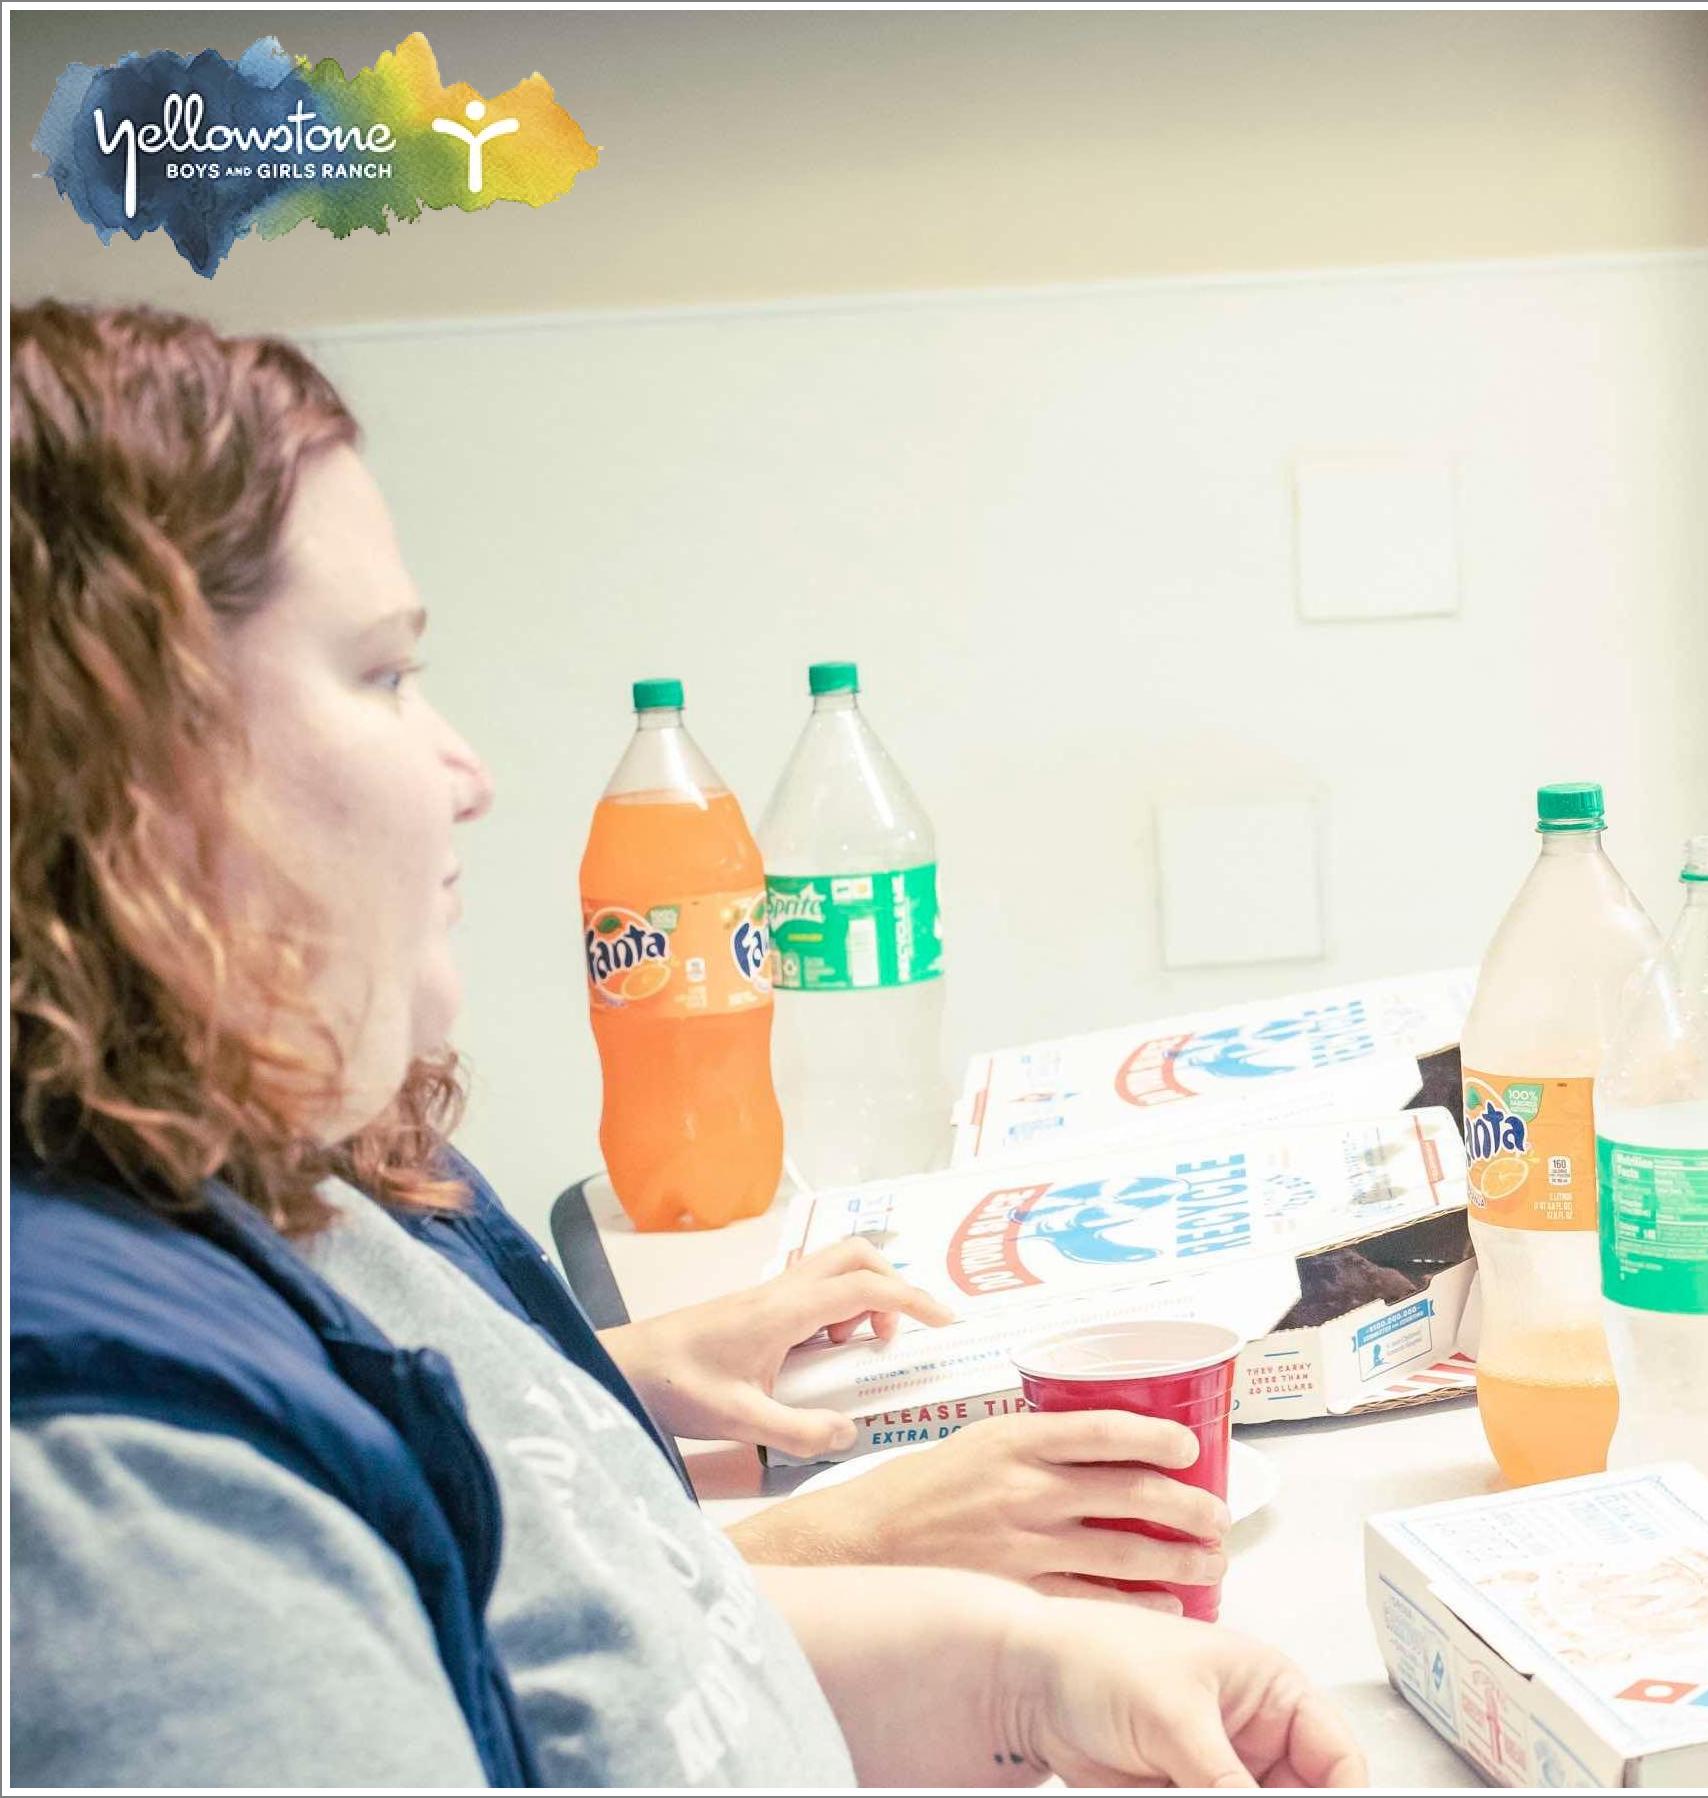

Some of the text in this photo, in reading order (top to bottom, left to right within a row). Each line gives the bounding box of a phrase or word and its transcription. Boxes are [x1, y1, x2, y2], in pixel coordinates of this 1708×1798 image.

[1175, 1153, 1251, 1258] RECYCLE
[864, 1402, 969, 1428] PLEASE
[872, 1428, 930, 1445] EXTRA
